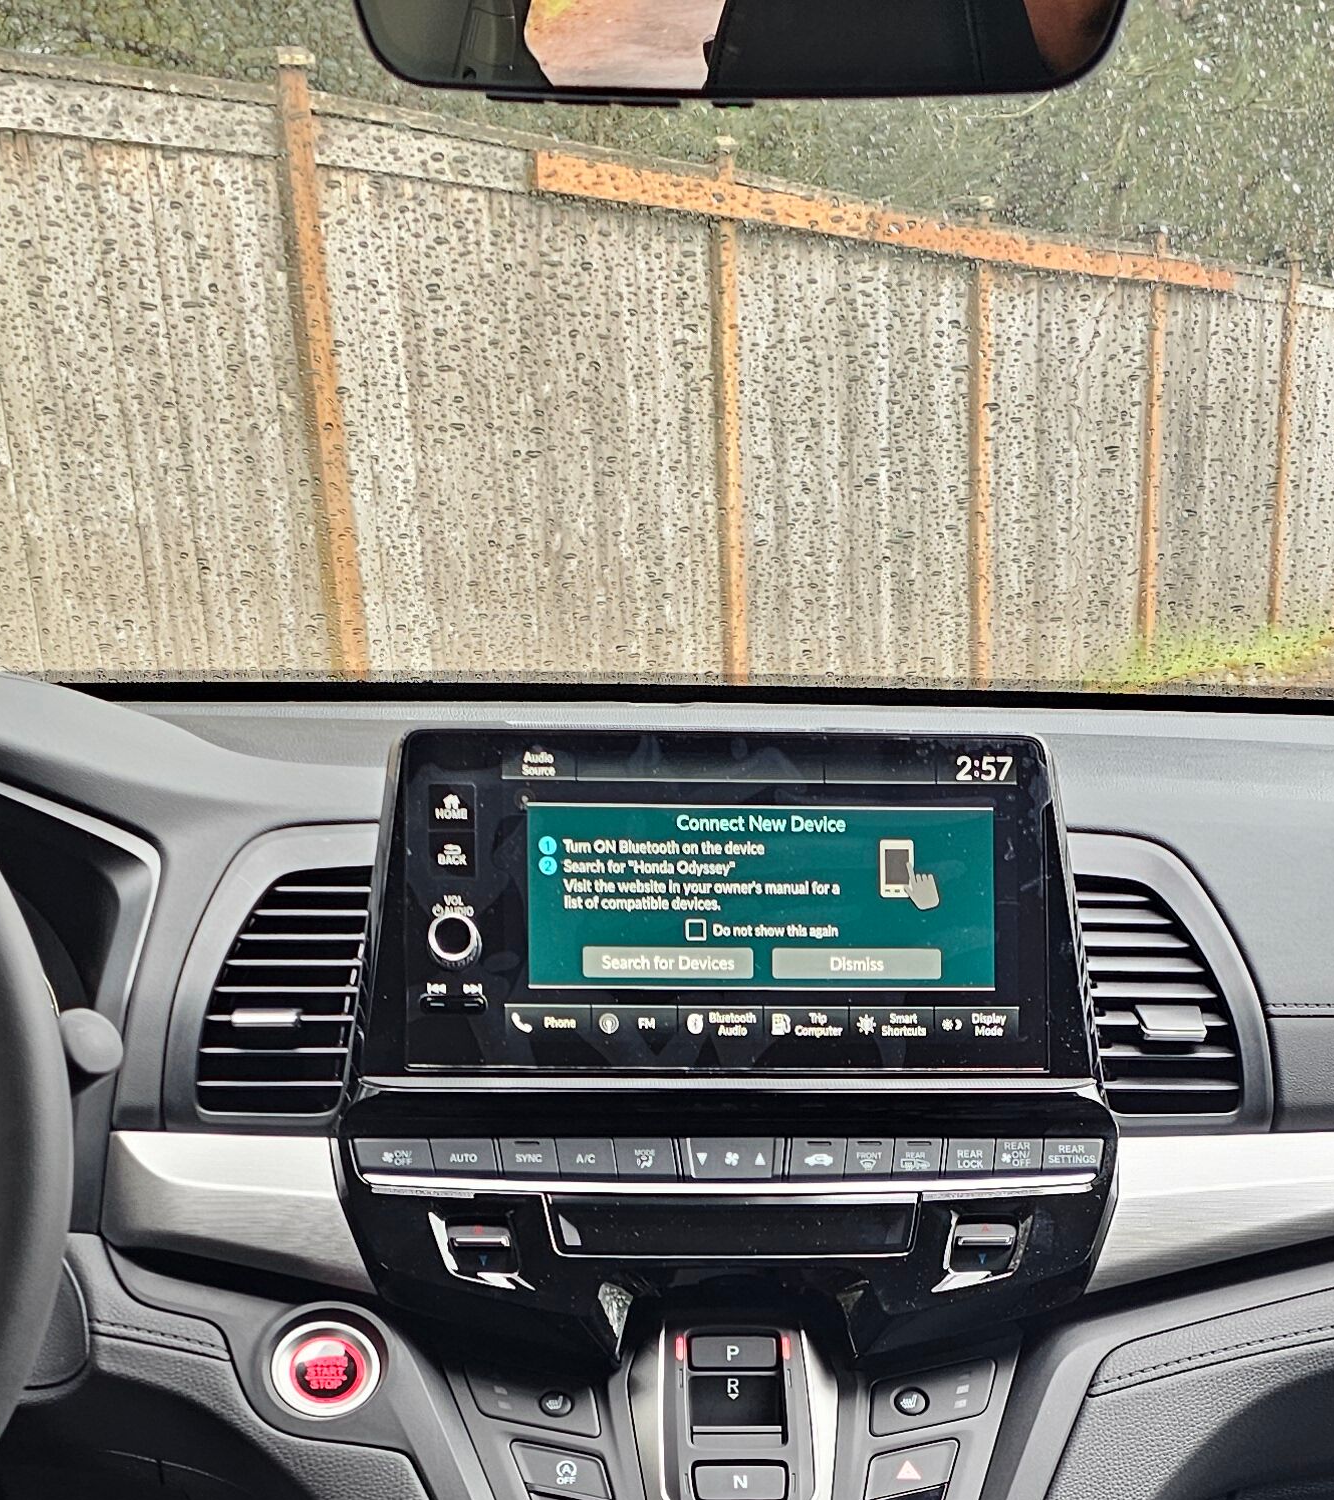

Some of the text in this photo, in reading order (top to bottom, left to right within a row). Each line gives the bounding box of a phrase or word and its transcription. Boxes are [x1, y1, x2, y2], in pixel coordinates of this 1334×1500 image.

[523, 751, 555, 764] Audio
[521, 764, 556, 777] Source
[955, 755, 1013, 781] 2:57
[434, 808, 468, 820] HOME
[676, 814, 846, 833] Connect New Device
[563, 839, 765, 855] Turn ON Bluetooth on the device
[438, 853, 467, 866] BACK
[563, 860, 736, 877] Search for "Honda Odyssey"
[563, 879, 830, 896] Visit the website in your owner's manual for
[443, 895, 464, 906] VOL
[564, 896, 721, 913] list of compatible devices.
[444, 906, 475, 918] AUDIO
[712, 924, 839, 940] Do not show this again
[601, 955, 735, 971] Search for Devices
[830, 956, 884, 972] Dismiss
[543, 1016, 577, 1030] Phone
[637, 1017, 656, 1030] FM
[708, 1011, 757, 1025] Bluetooth
[808, 1012, 828, 1027] Trip
[889, 1012, 918, 1025] Smart
[972, 1012, 1007, 1026] Display
[718, 1024, 748, 1037] Audio
[794, 1024, 843, 1039] Computer
[881, 1024, 927, 1038] Shortcuts
[975, 1024, 1004, 1037] Mode
[1004, 1141, 1031, 1150] REAR
[1058, 1145, 1085, 1154] REAR
[393, 1150, 412, 1159] ON/
[449, 1153, 478, 1164] AUTO
[515, 1153, 543, 1164] SYNC
[576, 1153, 596, 1164] A/C
[634, 1149, 655, 1157] MODE
[856, 1152, 882, 1160] FRONT
[905, 1151, 926, 1159] REAR
[957, 1150, 983, 1159] REAR
[1012, 1150, 1031, 1159] ON/
[1048, 1154, 1097, 1164] SETTINGS
[393, 1158, 412, 1167] OFF
[957, 1159, 984, 1169] LOCK
[1012, 1158, 1031, 1167] OFF
[726, 1345, 740, 1361] P
[306, 1366, 346, 1377] START
[309, 1380, 343, 1390] STOP
[727, 1378, 739, 1393] R
[556, 1477, 576, 1485] OFF
[733, 1475, 747, 1489] N
